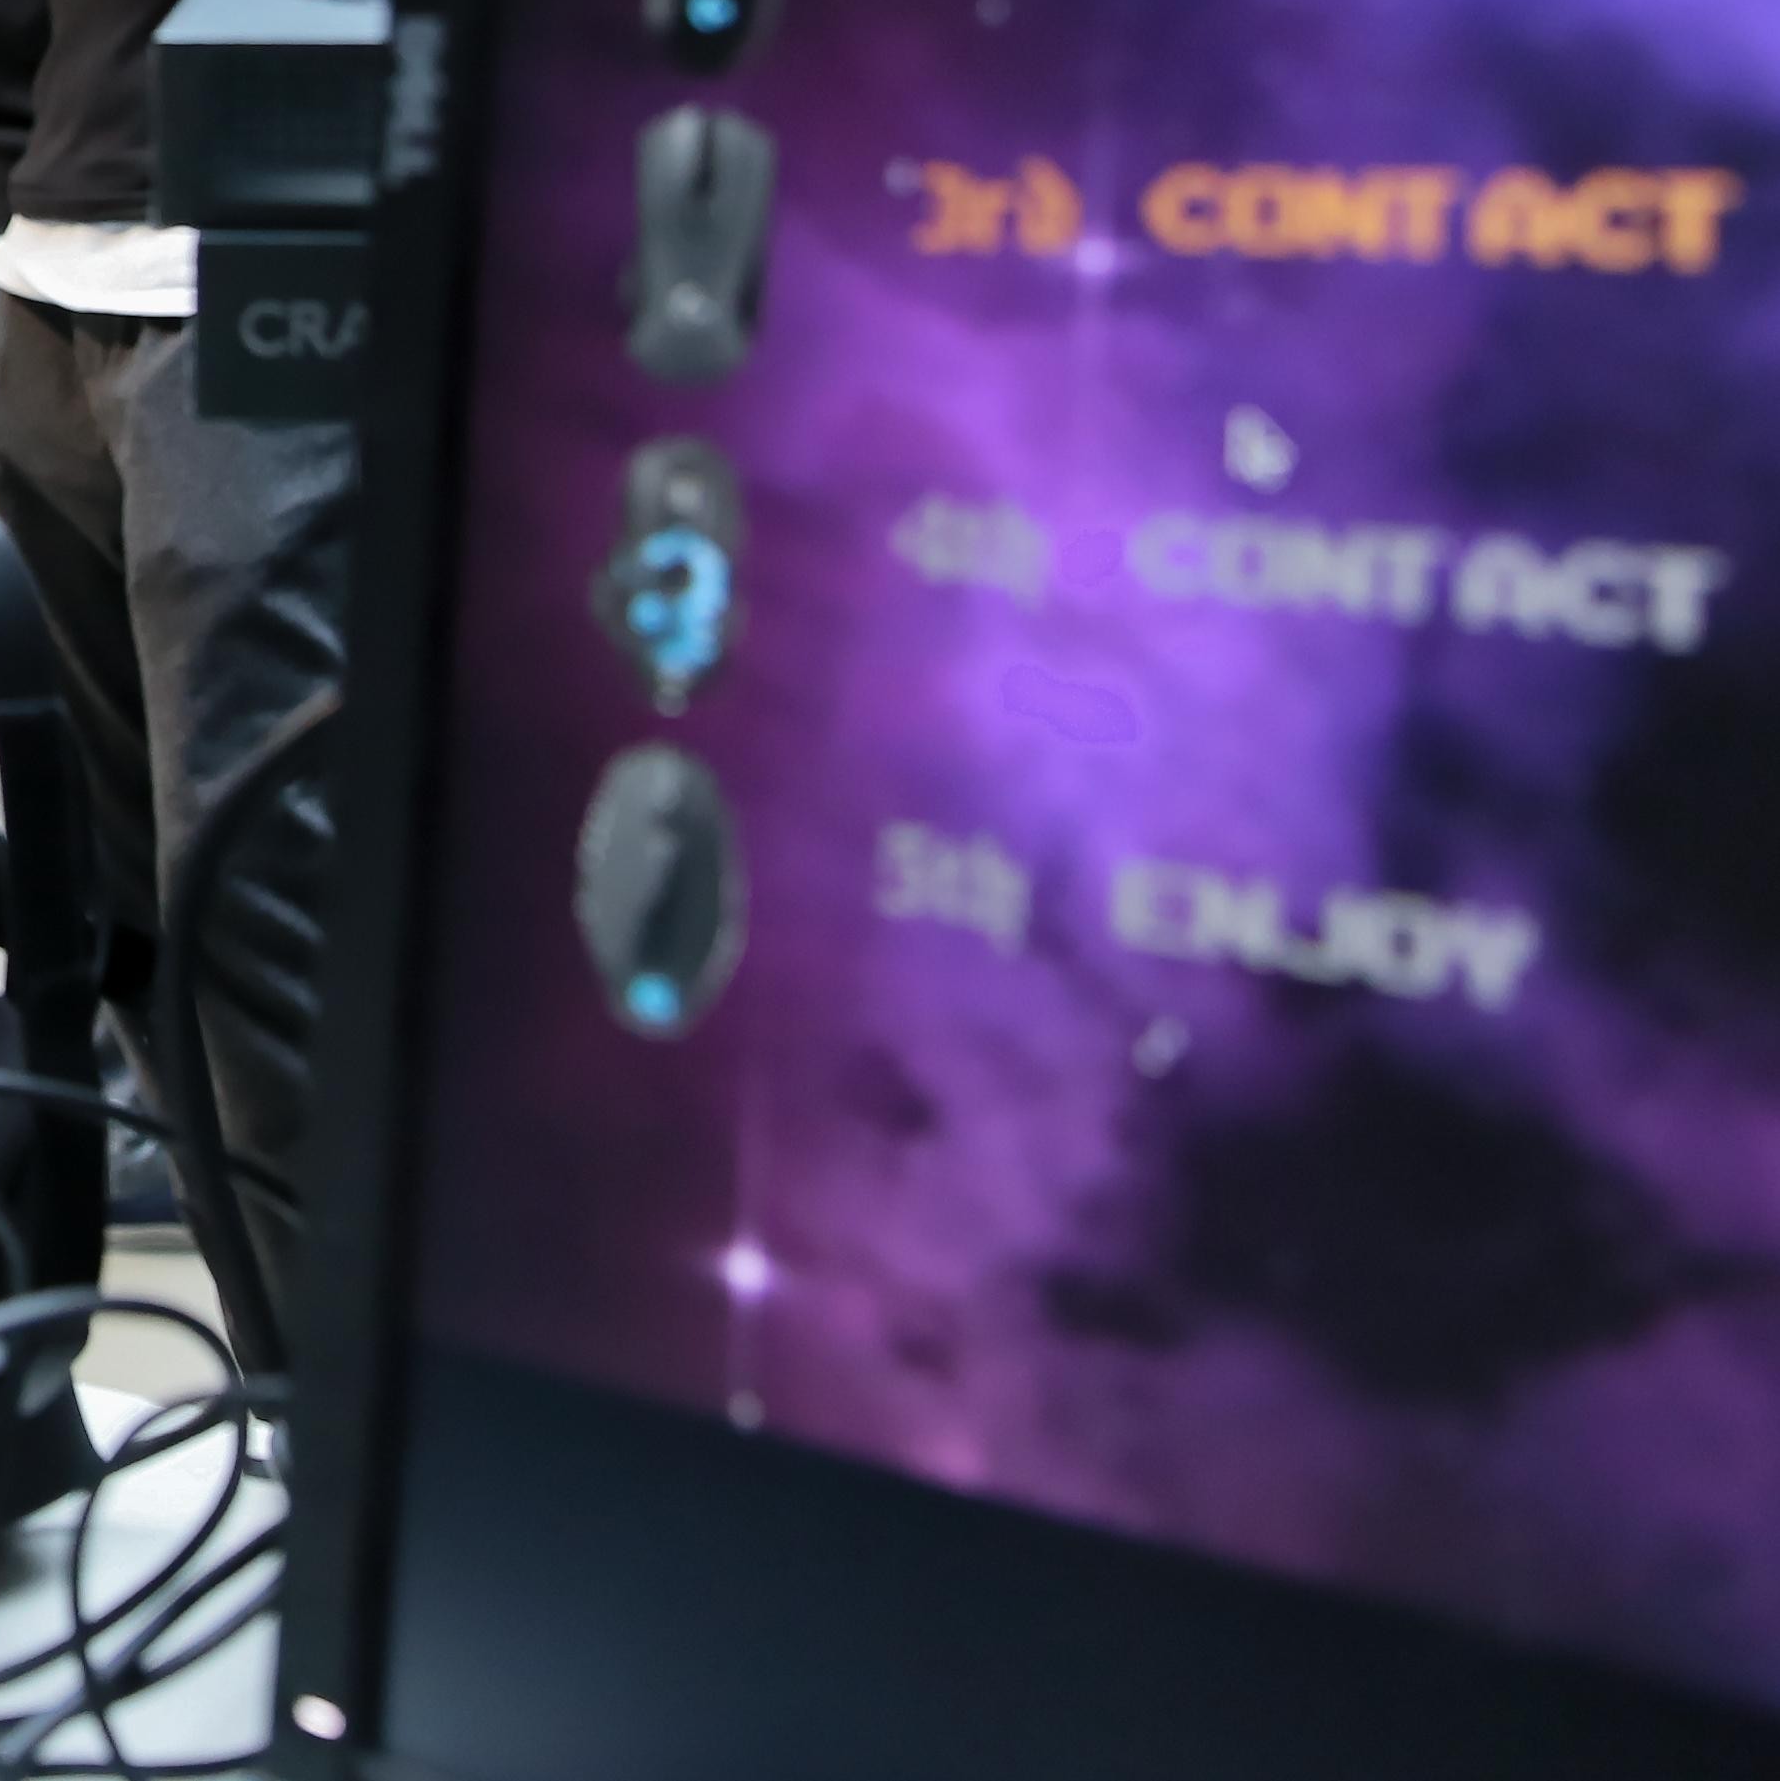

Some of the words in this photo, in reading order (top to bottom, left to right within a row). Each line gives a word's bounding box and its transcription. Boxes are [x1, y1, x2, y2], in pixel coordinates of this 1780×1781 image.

[1138, 162, 1741, 275] CONTACT
[1126, 510, 1730, 654] CONTACT
[1110, 855, 1539, 1011] ENJOY
